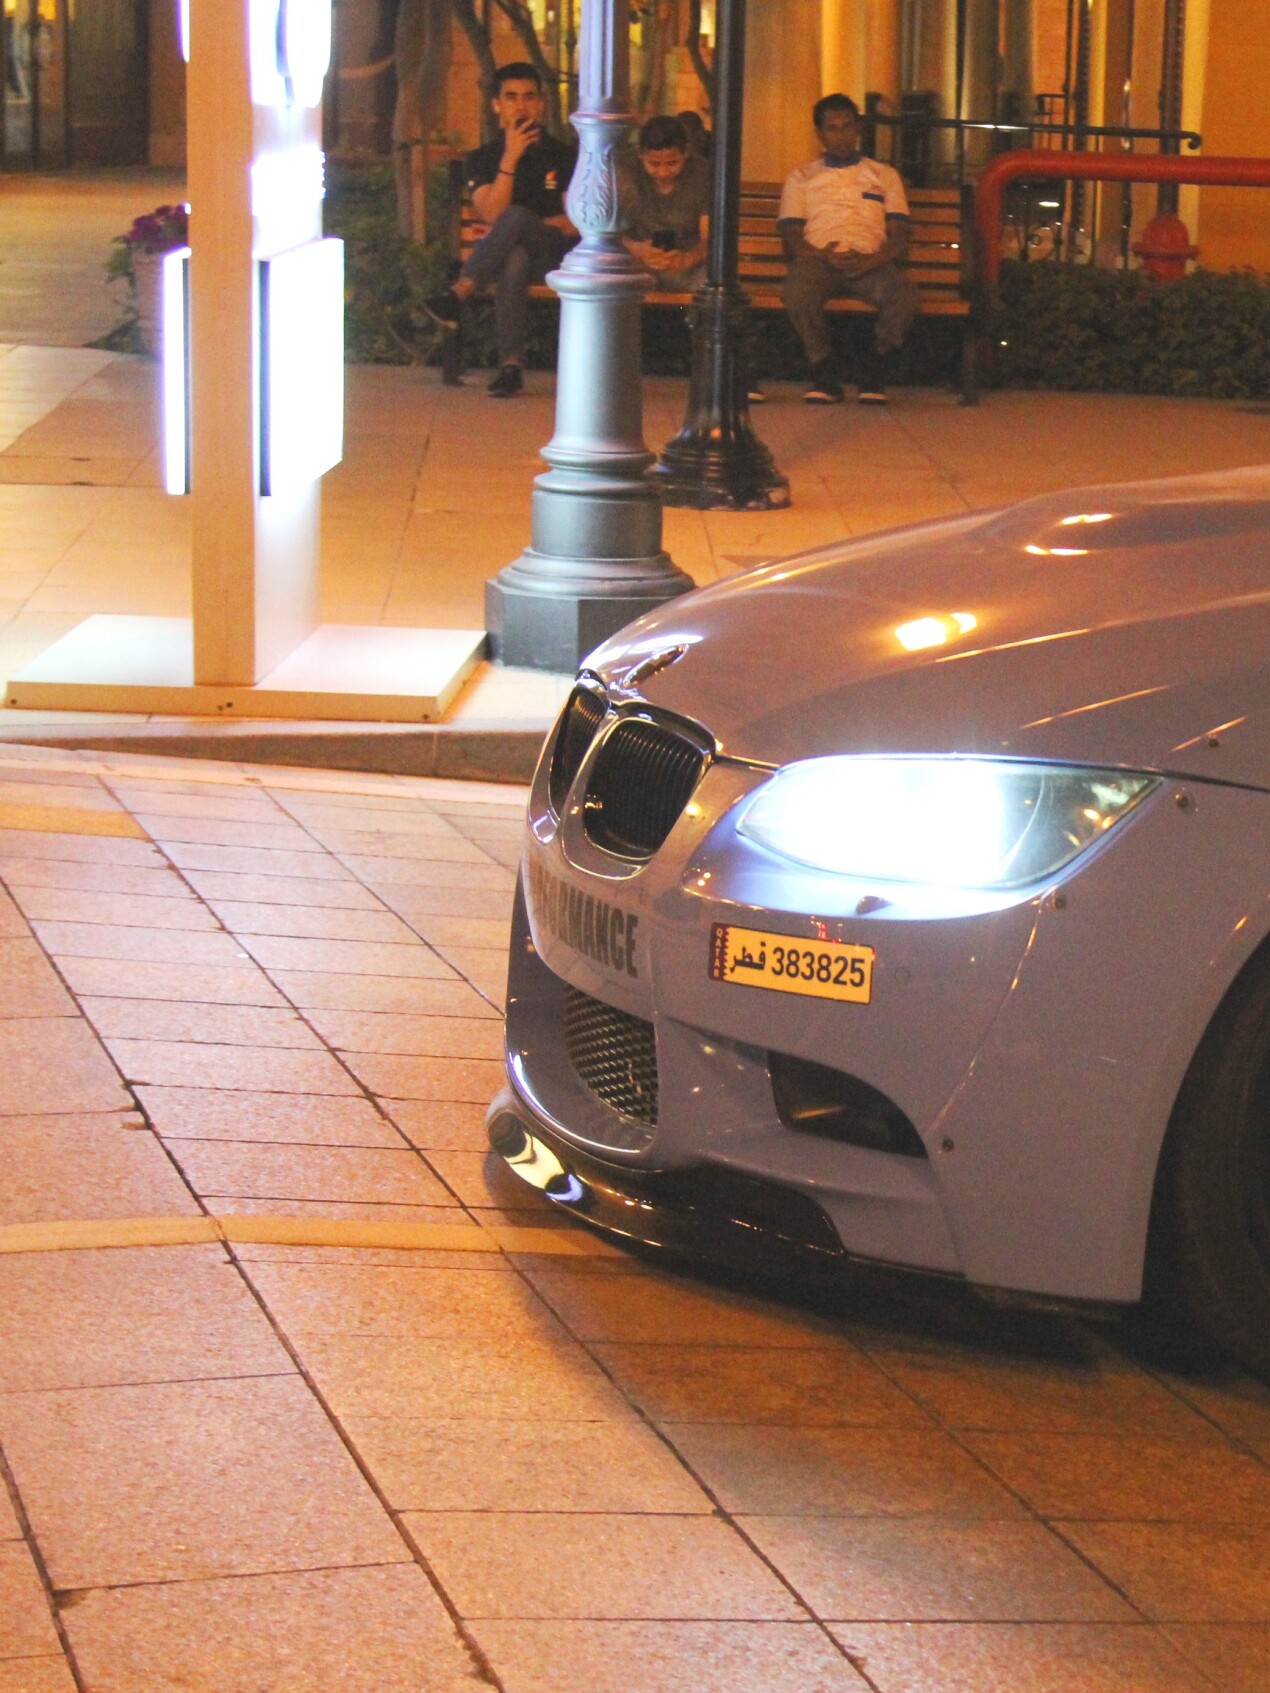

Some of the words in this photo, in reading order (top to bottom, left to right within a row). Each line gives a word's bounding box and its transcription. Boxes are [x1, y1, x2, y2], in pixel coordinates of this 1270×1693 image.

[713, 927, 724, 978] QATAR
[730, 941, 766, 973] قطر
[771, 946, 866, 988] 383825
